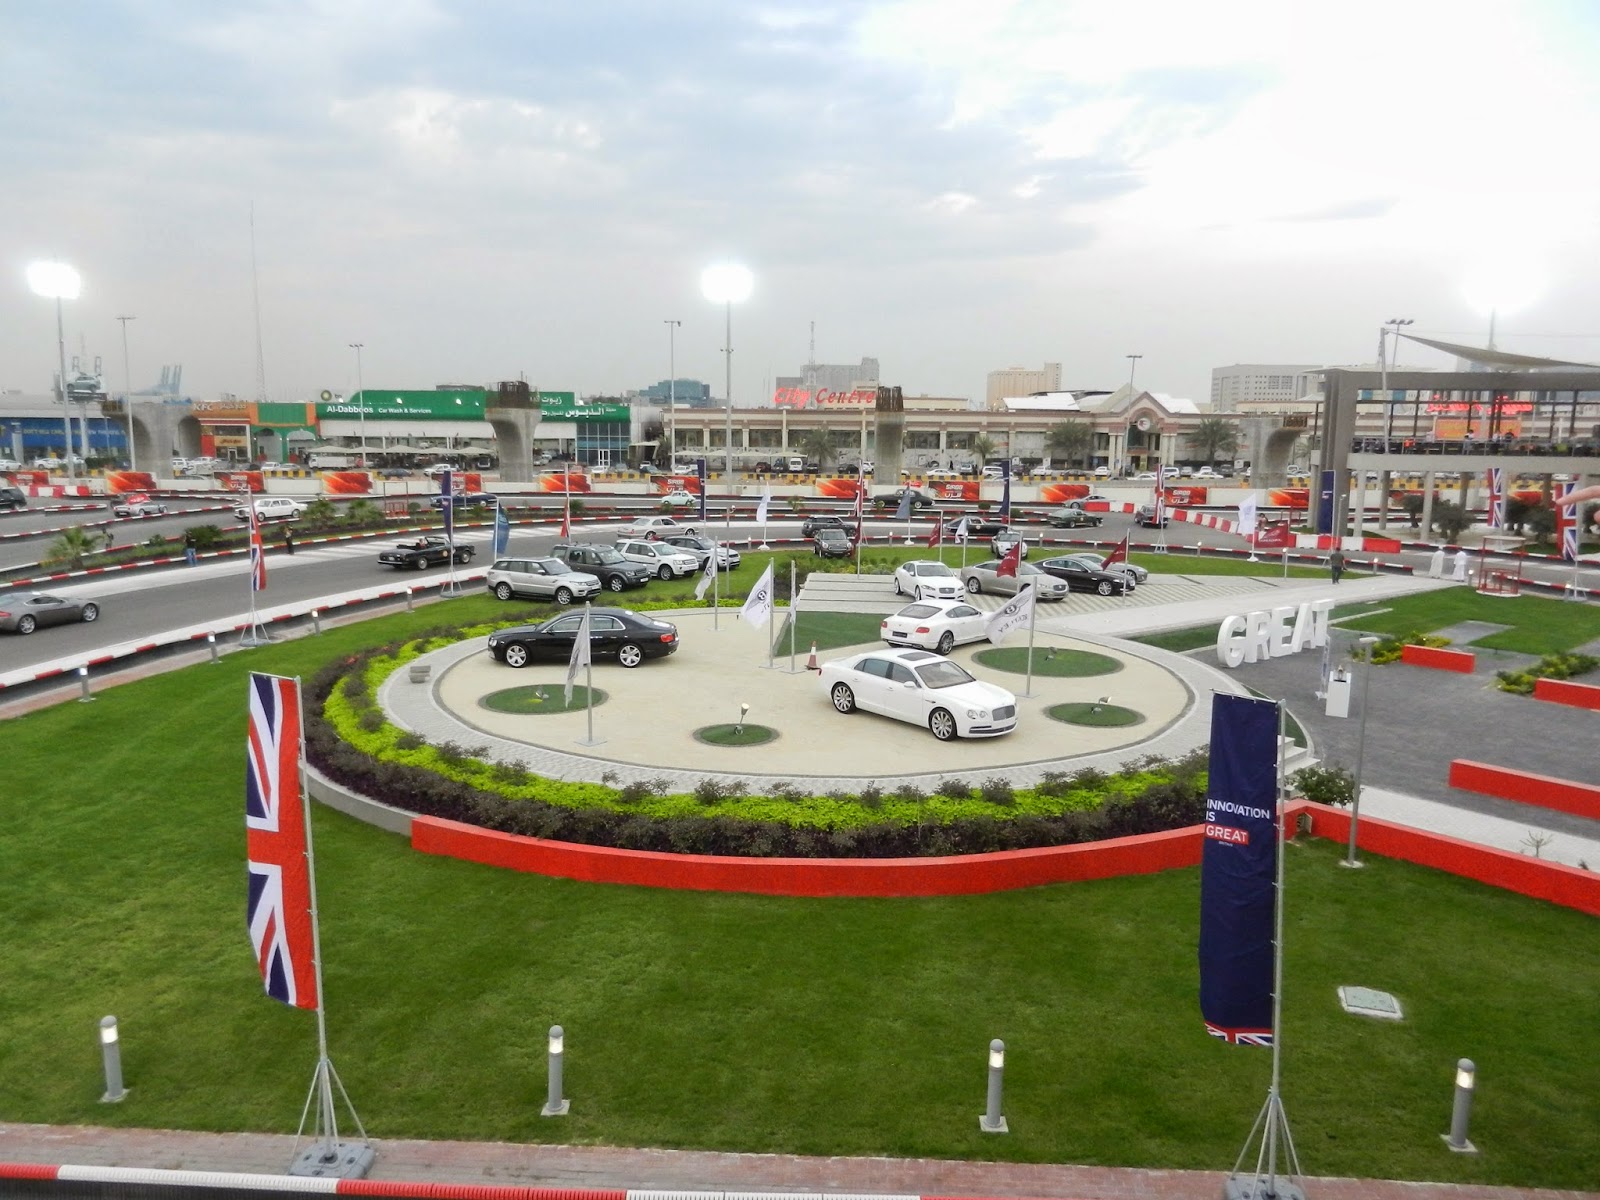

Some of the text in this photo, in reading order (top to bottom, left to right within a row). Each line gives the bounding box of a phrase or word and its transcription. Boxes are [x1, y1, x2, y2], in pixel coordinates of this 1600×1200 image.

[774, 387, 876, 409] City Centre
[193, 403, 213, 411] KFC
[326, 405, 374, 413] Al-Dabboos
[1217, 599, 1335, 668] GREAT
[1205, 811, 1216, 822] IS
[1206, 798, 1270, 819] INNOVATION
[1206, 825, 1247, 842] GREAT
